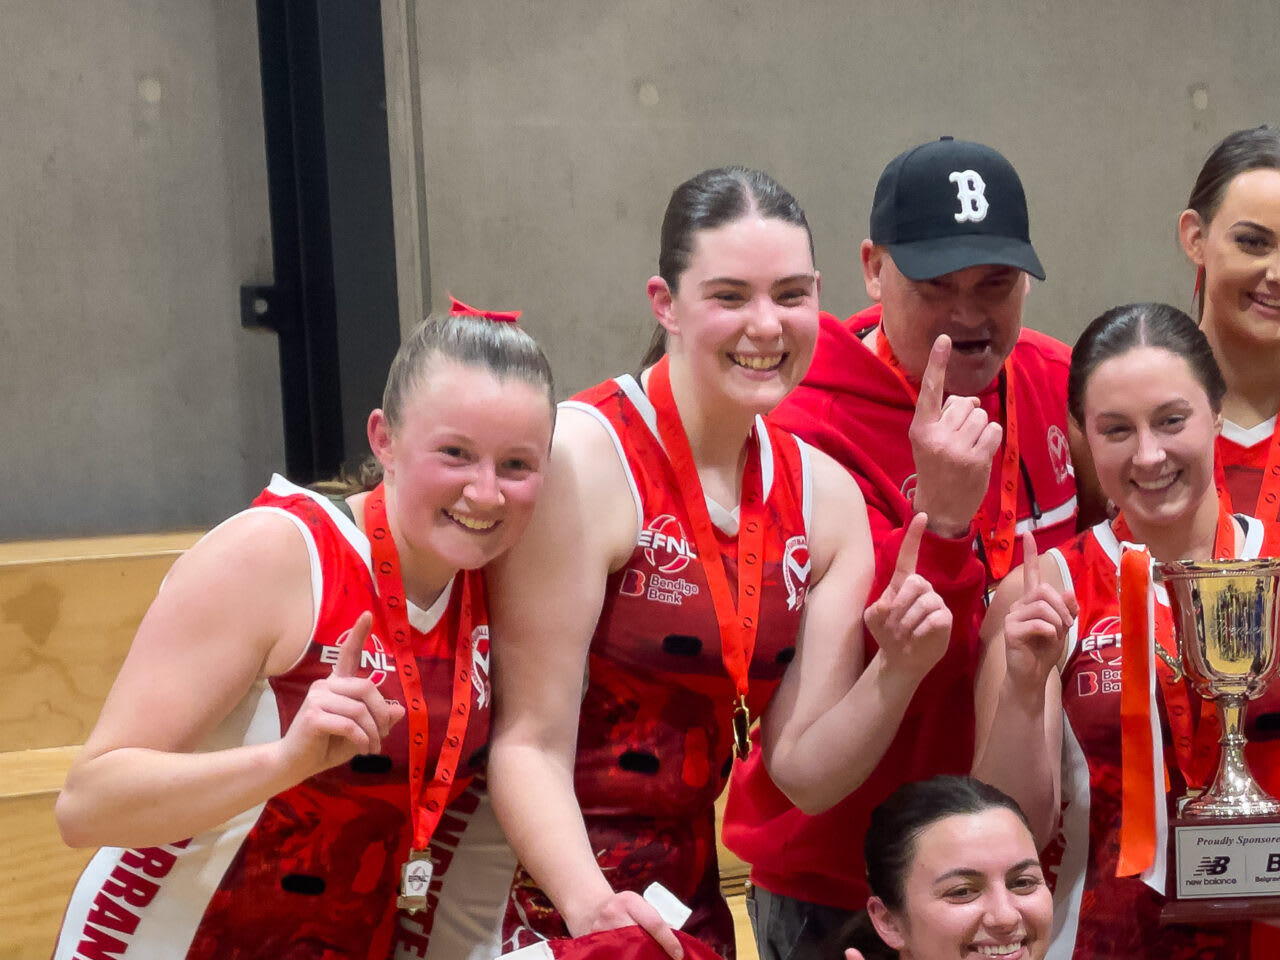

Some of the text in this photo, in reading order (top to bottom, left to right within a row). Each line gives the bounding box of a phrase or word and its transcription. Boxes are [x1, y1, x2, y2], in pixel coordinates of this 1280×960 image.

[949, 169, 989, 223] B
[638, 530, 697, 559] EFNL
[647, 587, 682, 605] Bank
[650, 574, 699, 595] Bendigo
[320, 645, 396, 671] ENL
[1196, 837, 1234, 847] Proudly
